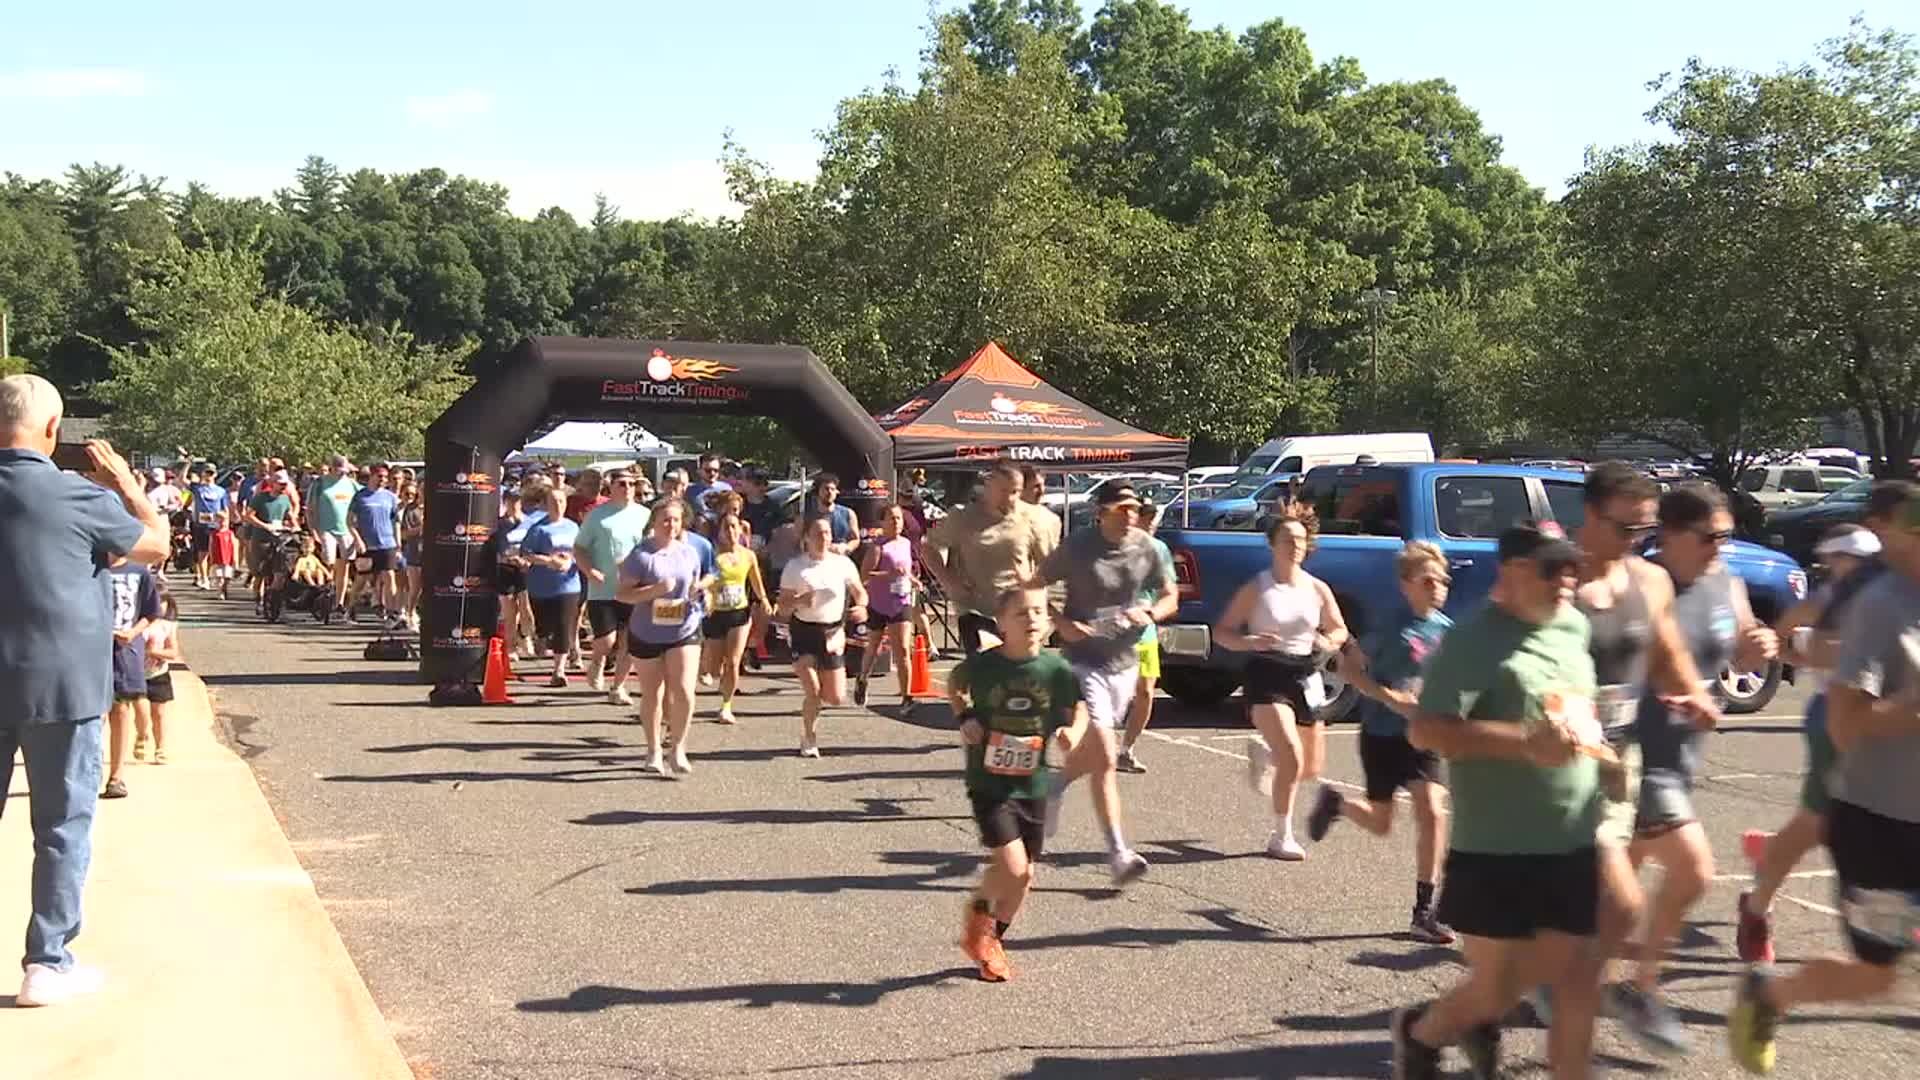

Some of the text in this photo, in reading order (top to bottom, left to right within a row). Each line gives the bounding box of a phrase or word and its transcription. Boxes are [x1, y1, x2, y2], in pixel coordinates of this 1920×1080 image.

[956, 445, 1134, 462] FAST TRACK TIMING
